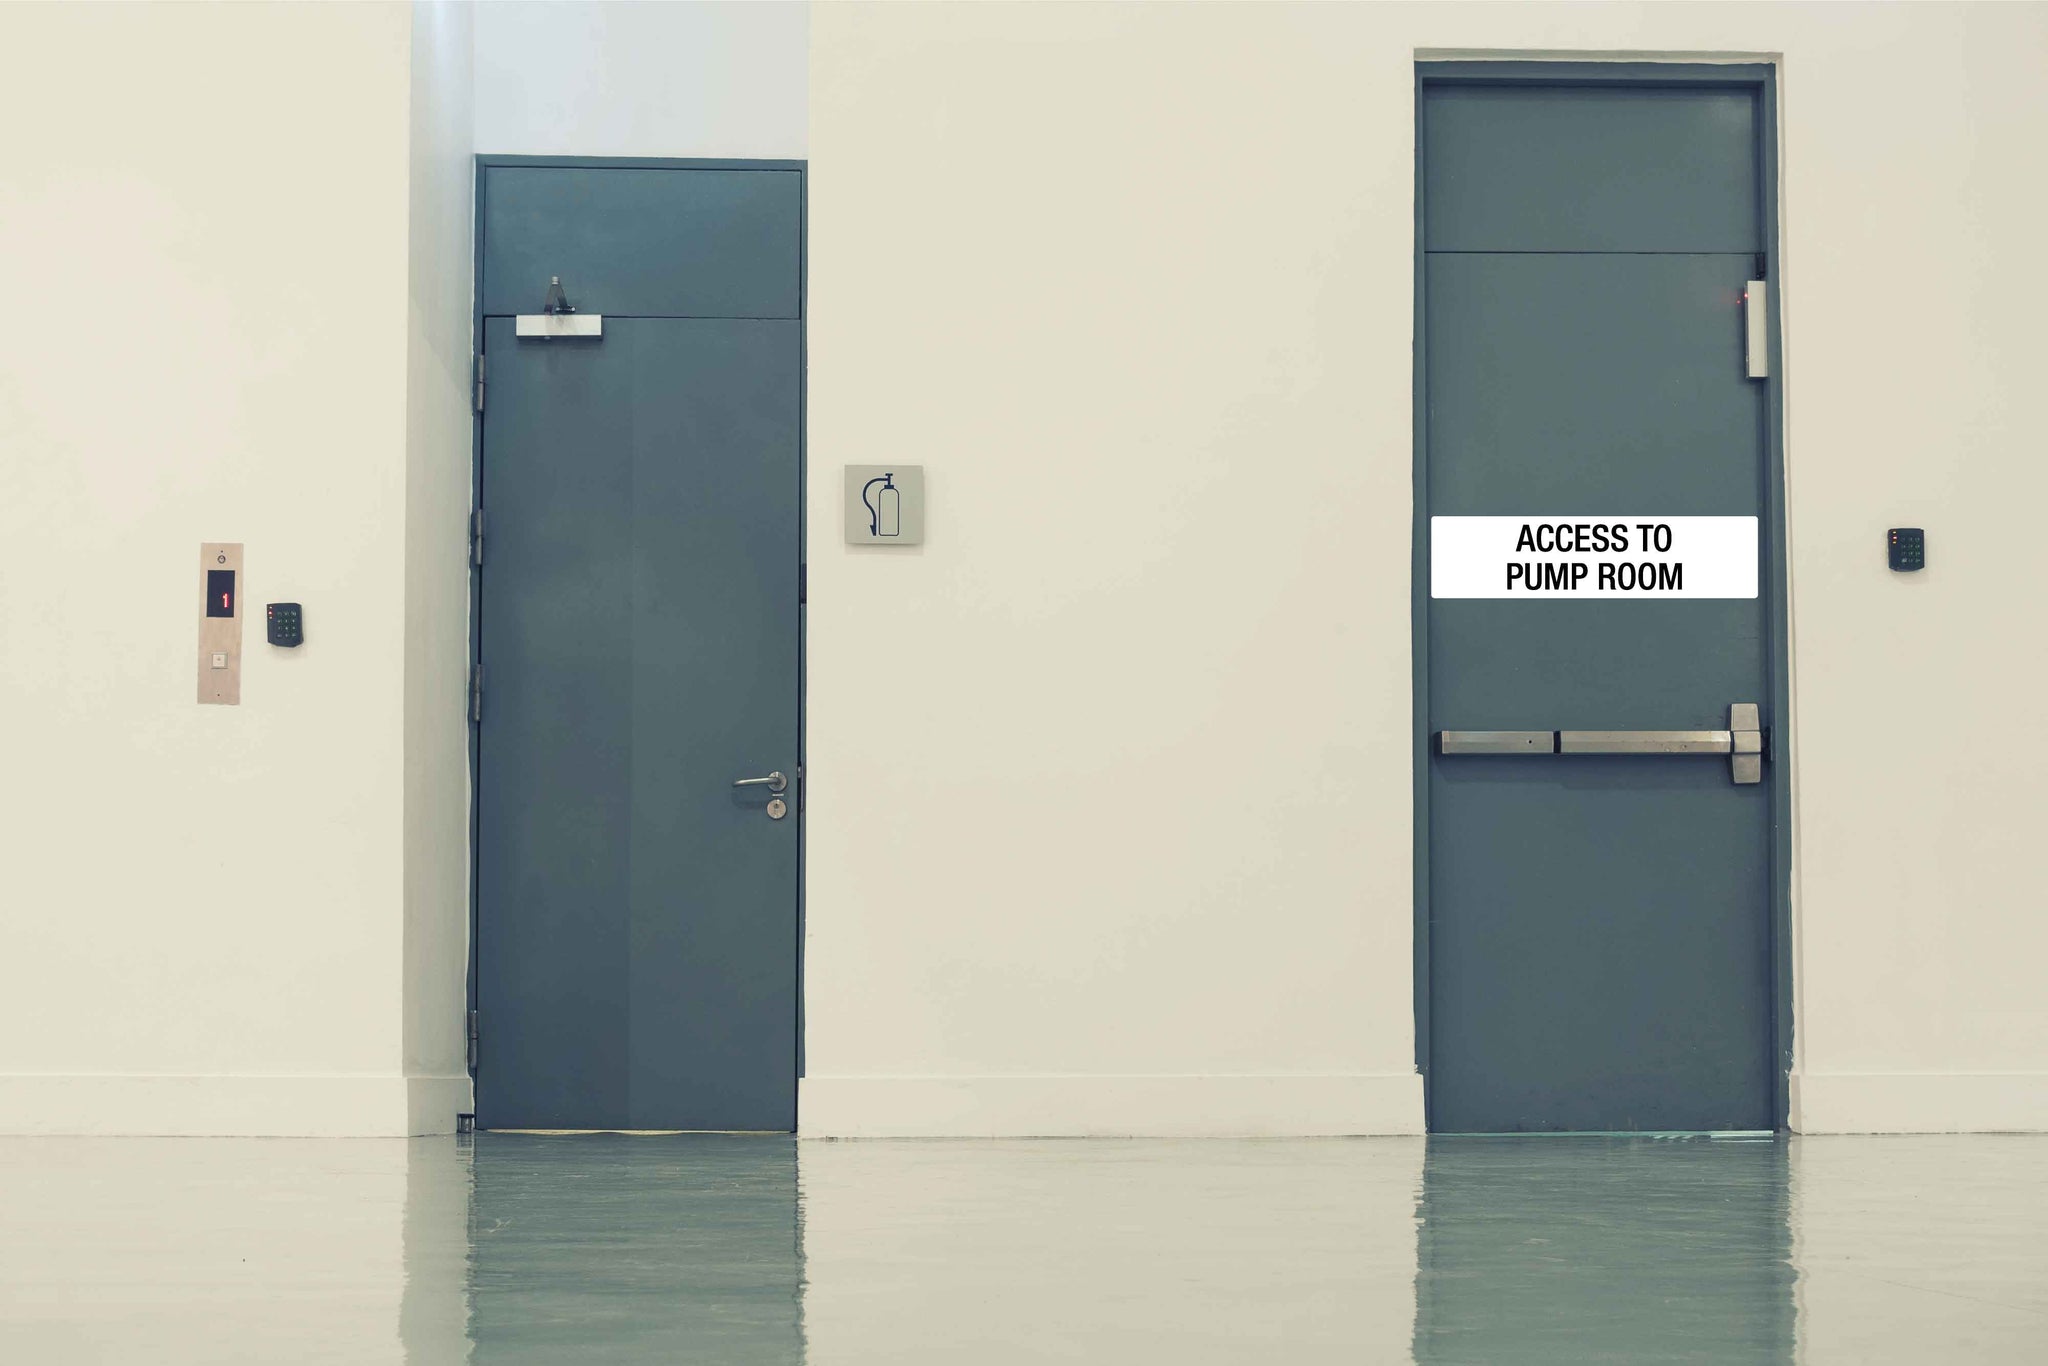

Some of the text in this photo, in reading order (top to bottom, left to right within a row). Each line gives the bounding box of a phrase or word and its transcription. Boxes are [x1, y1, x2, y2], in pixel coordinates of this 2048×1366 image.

[1515, 523, 1672, 553] ACCESS TO
[1506, 562, 1683, 591] PUMP ROOM
[222, 592, 229, 608] 1
